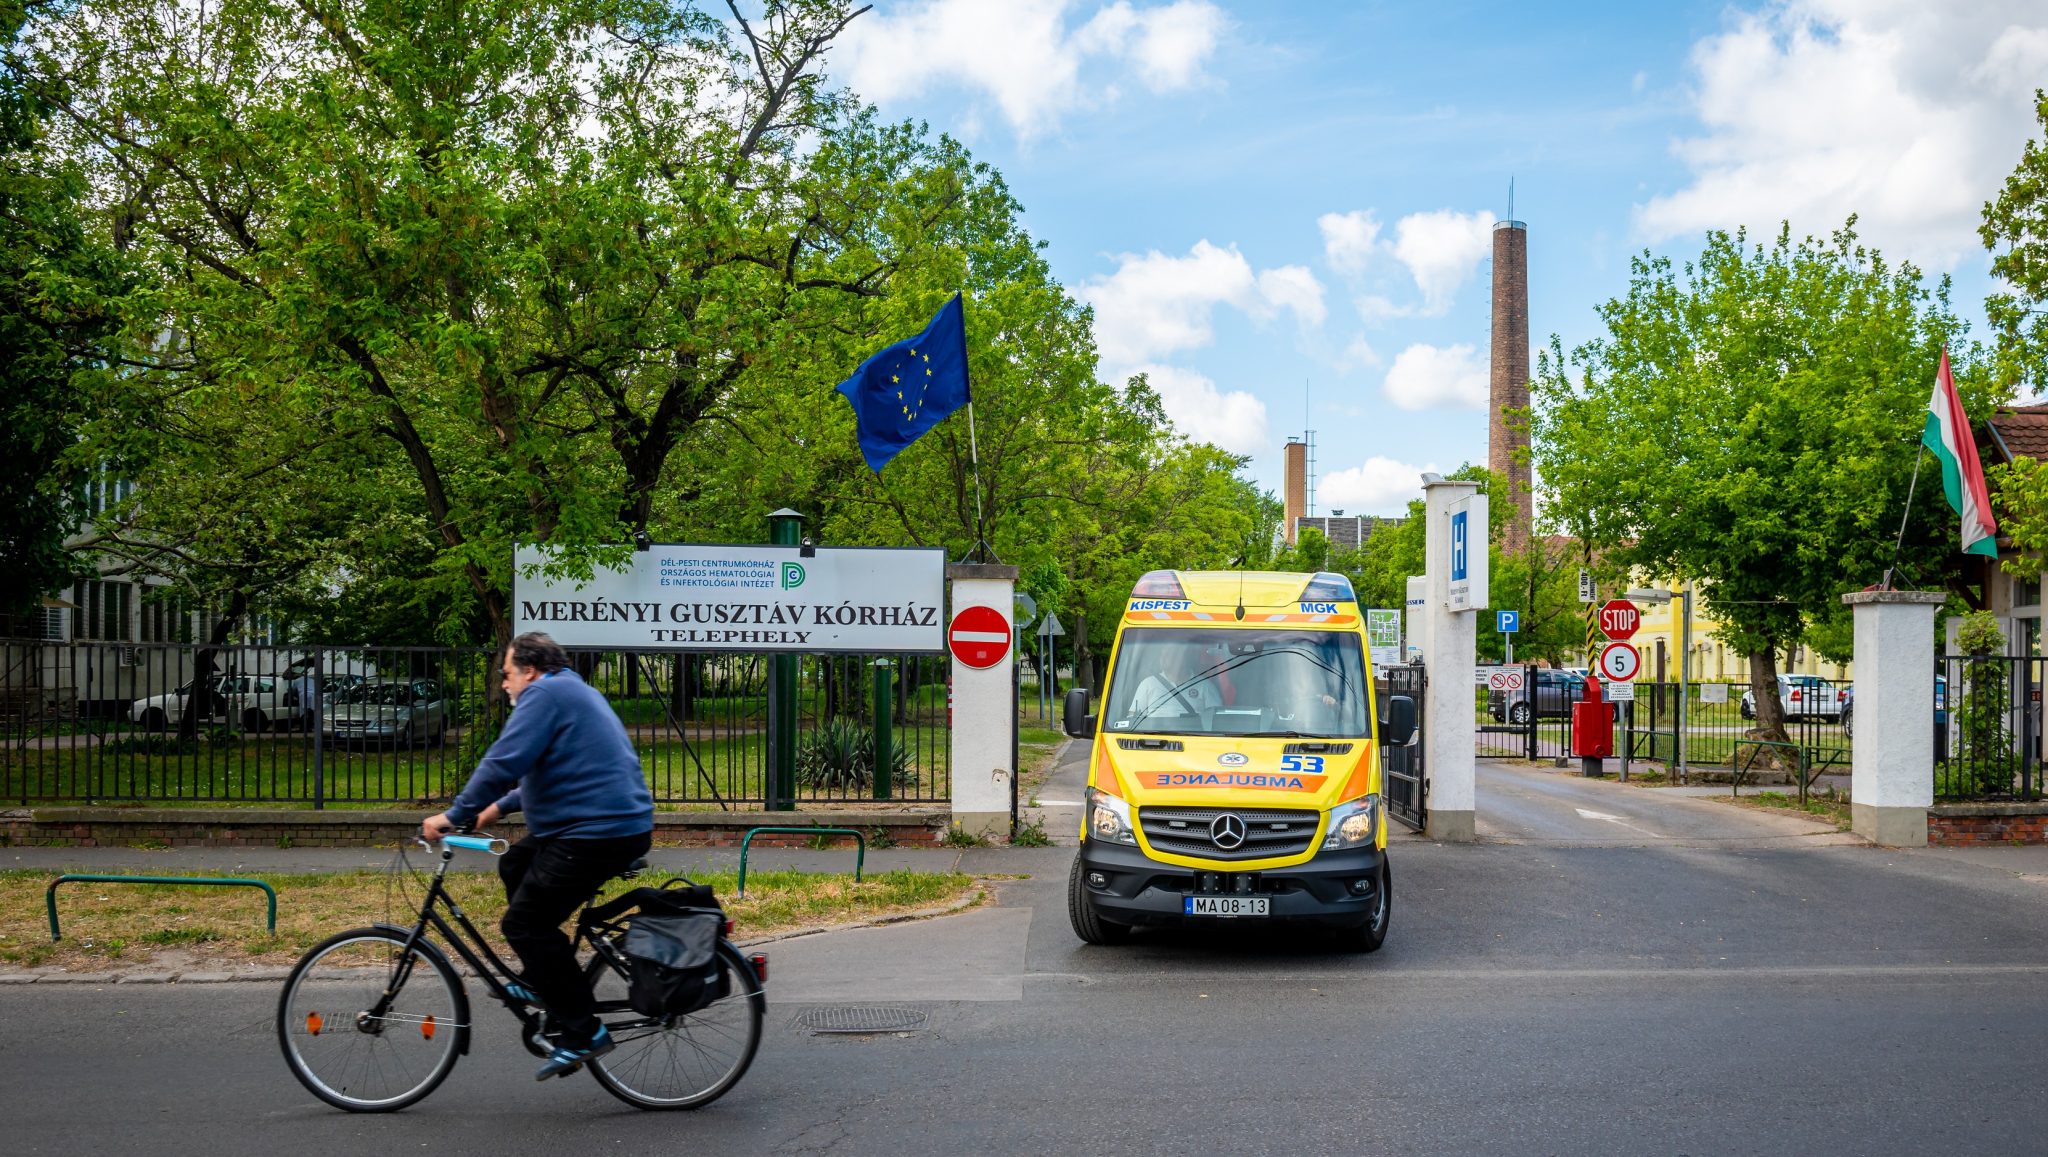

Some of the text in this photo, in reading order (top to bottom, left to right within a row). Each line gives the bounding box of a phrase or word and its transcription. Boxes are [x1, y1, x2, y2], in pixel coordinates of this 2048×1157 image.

[660, 558, 775, 569] DÉL-PESTI CENTRUMKÓRHÁZ
[660, 568, 775, 578] ORSZÁGOS HEMATOLÓGIAI
[660, 577, 775, 588] ÉS INFEKTOLÓGIAI INTÉZET
[521, 597, 938, 627] MERÉNYI GUSZTÁV KÓRHÁZ
[1130, 600, 1192, 611] KISPEST
[1301, 602, 1339, 614] MGK
[1502, 613, 1514, 631] P
[1603, 609, 1636, 631] STOP
[651, 630, 813, 644] TELEPHELY
[1615, 656, 1625, 672] 5
[1280, 754, 1325, 774] 53
